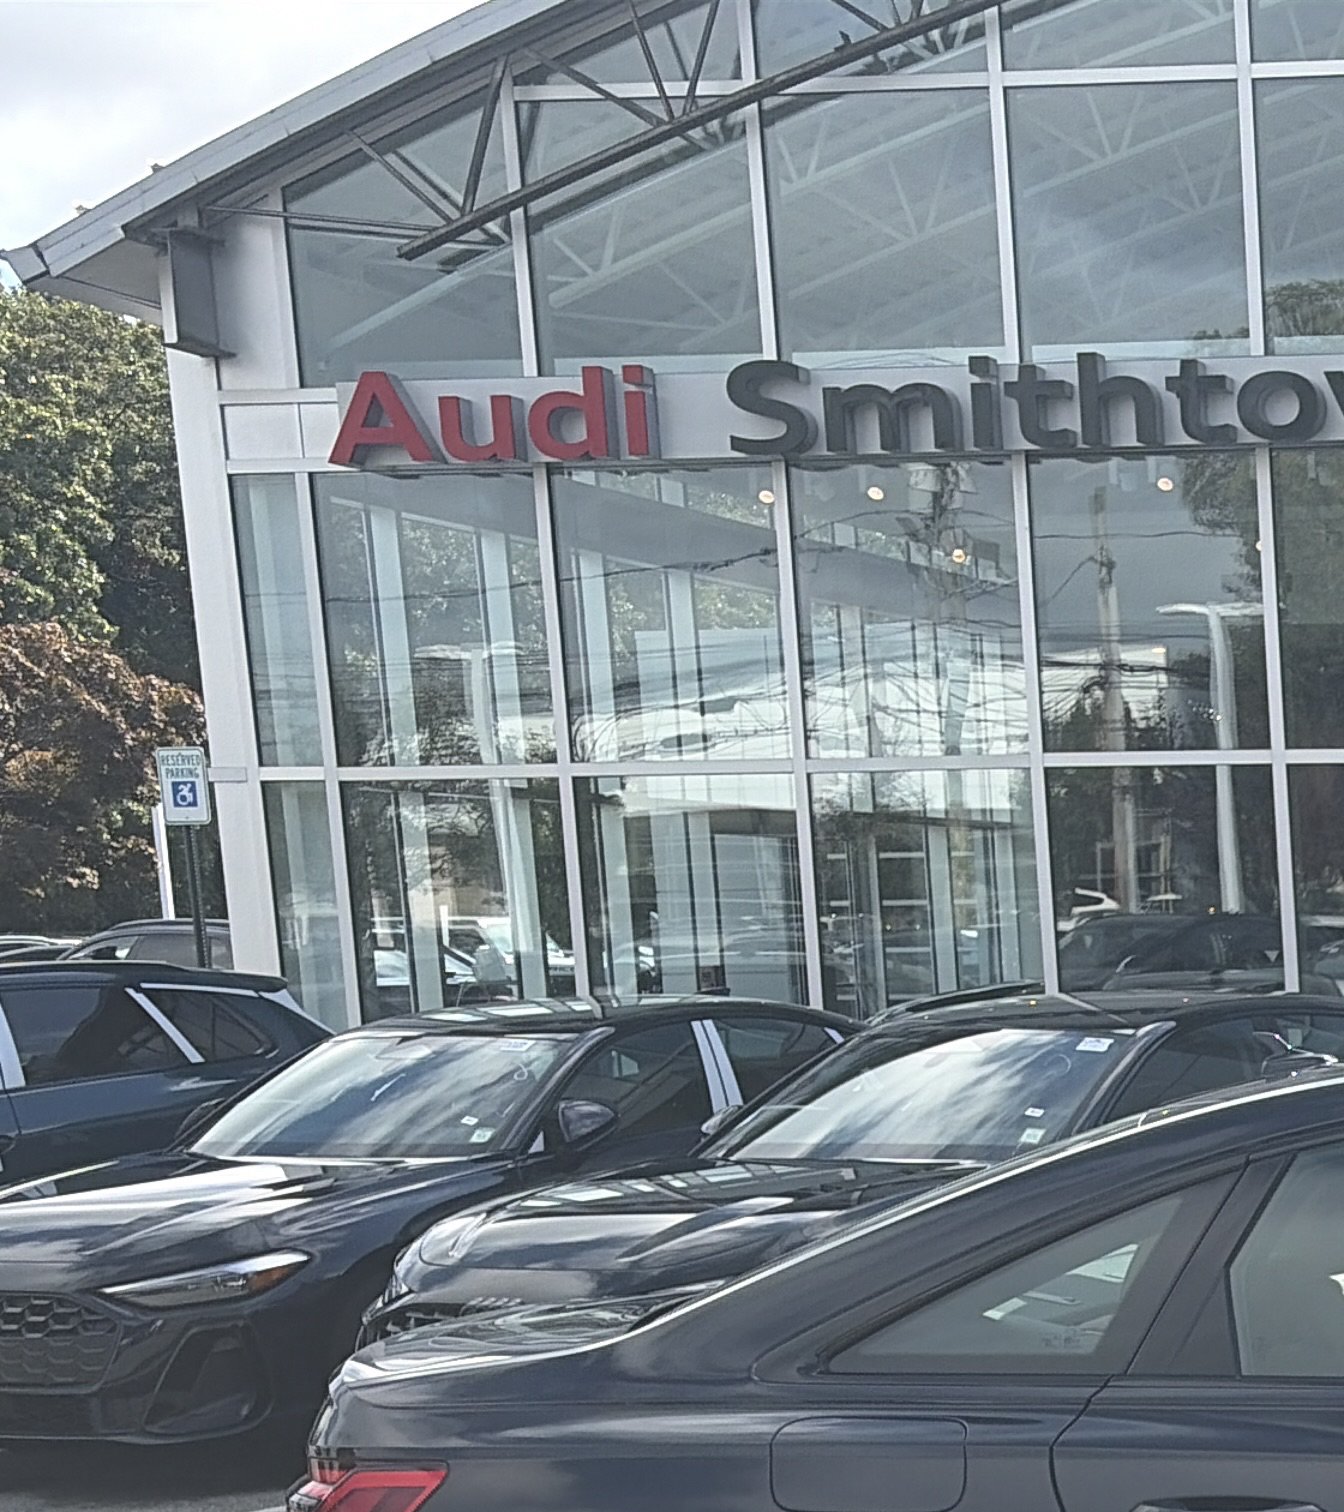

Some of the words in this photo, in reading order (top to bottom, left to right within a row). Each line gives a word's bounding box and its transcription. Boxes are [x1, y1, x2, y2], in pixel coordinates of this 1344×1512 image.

[329, 364, 655, 464] Audi
[160, 754, 201, 767] RESERVED
[165, 767, 200, 779] PARKING
